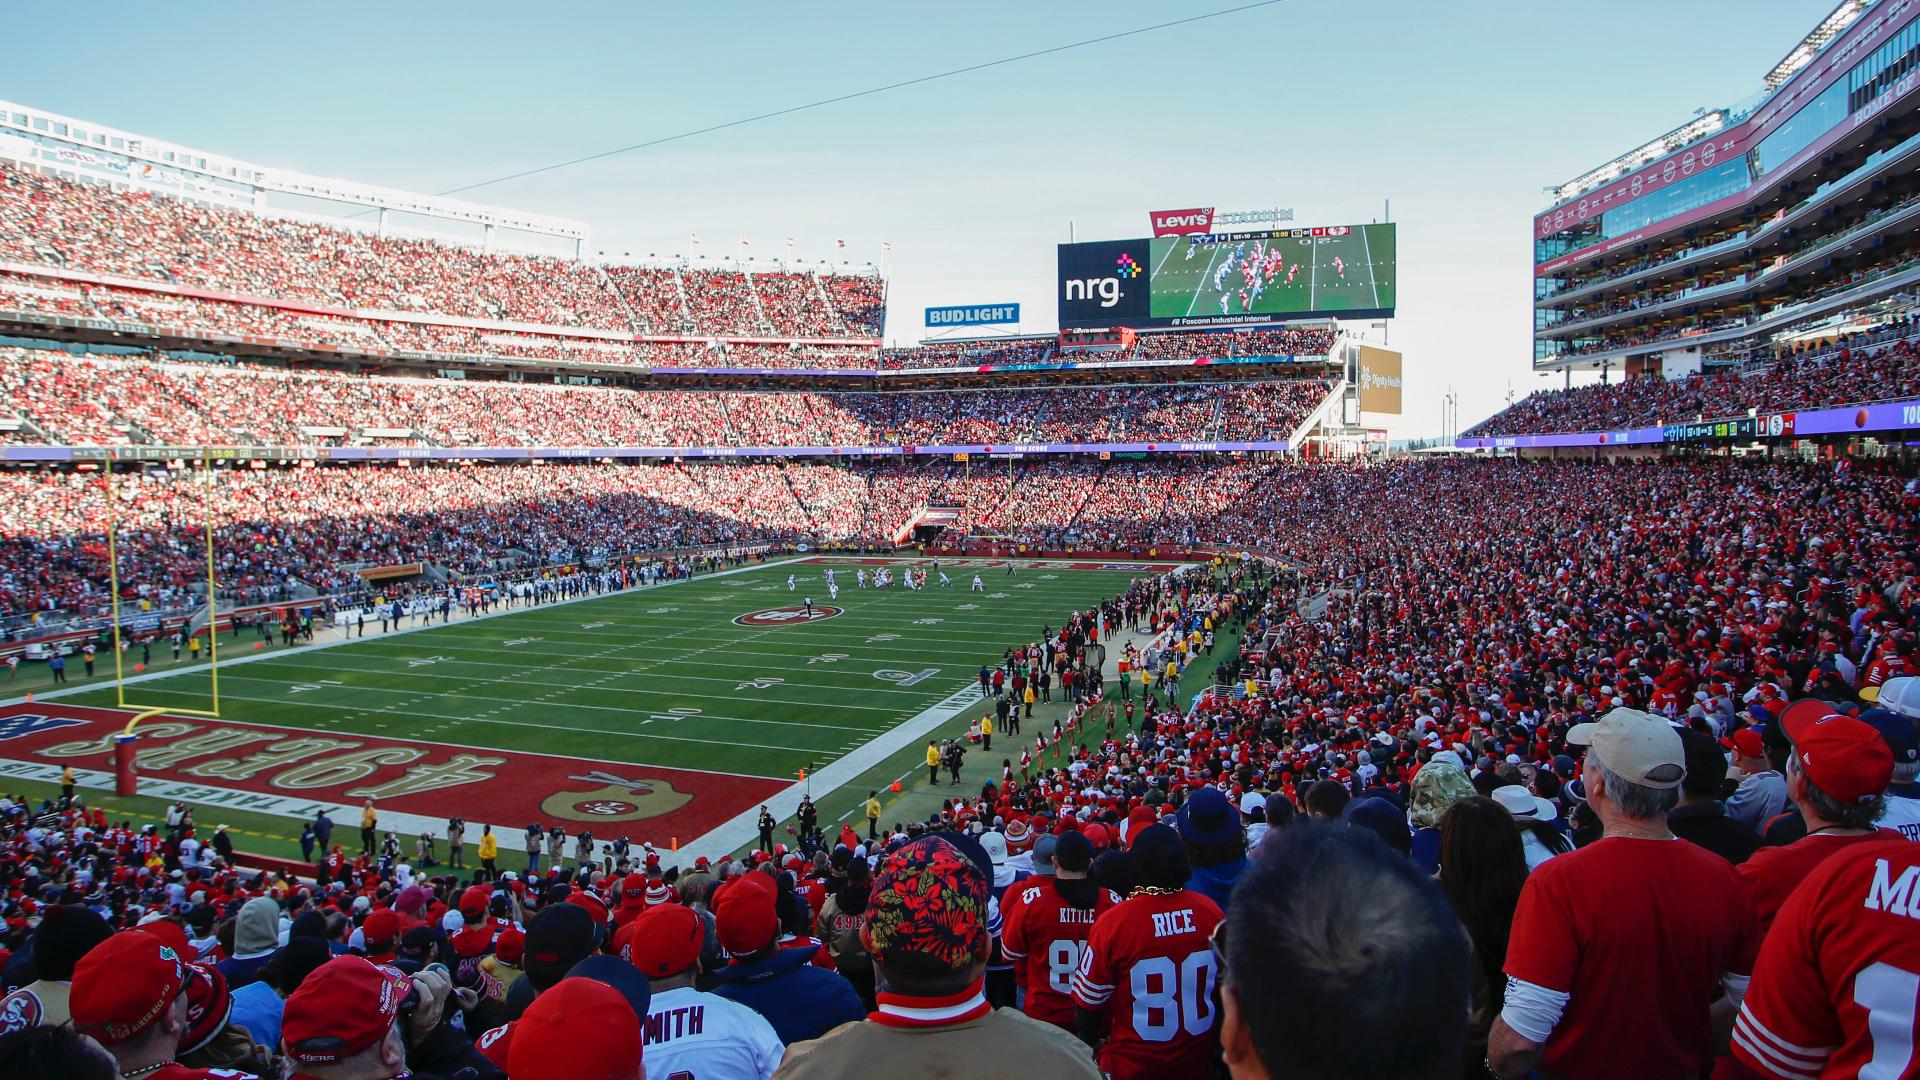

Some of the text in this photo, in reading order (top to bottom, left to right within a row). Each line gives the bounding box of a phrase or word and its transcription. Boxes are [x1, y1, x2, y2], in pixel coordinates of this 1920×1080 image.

[1182, 314, 1271, 325] Foxconn Industrial Internet
[738, 677, 785, 689] 20
[650, 707, 703, 722] 10
[164, 786, 286, 810] TAKES
[1898, 823, 1920, 842] PR
[1059, 907, 1095, 924] KITTLE
[1152, 909, 1197, 937] RICE
[1130, 950, 1218, 1041] 80
